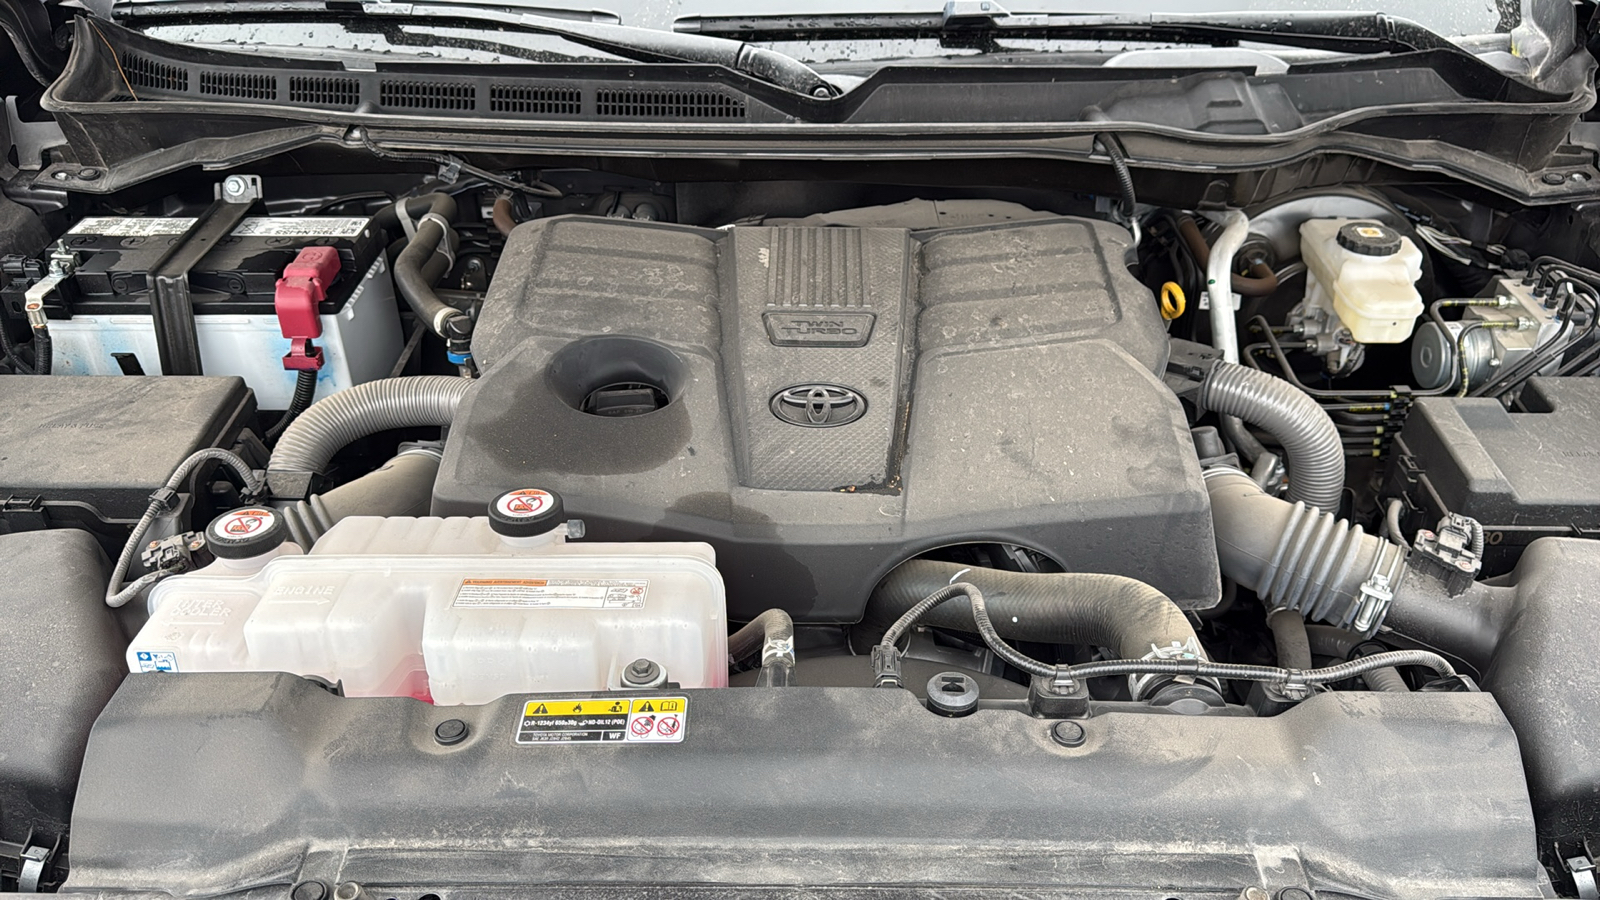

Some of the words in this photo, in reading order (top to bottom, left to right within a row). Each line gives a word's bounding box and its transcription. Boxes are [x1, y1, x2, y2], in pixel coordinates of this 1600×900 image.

[781, 327, 858, 335] TURBO
[273, 585, 335, 595] ENGINE
[170, 607, 232, 617] COOLER
